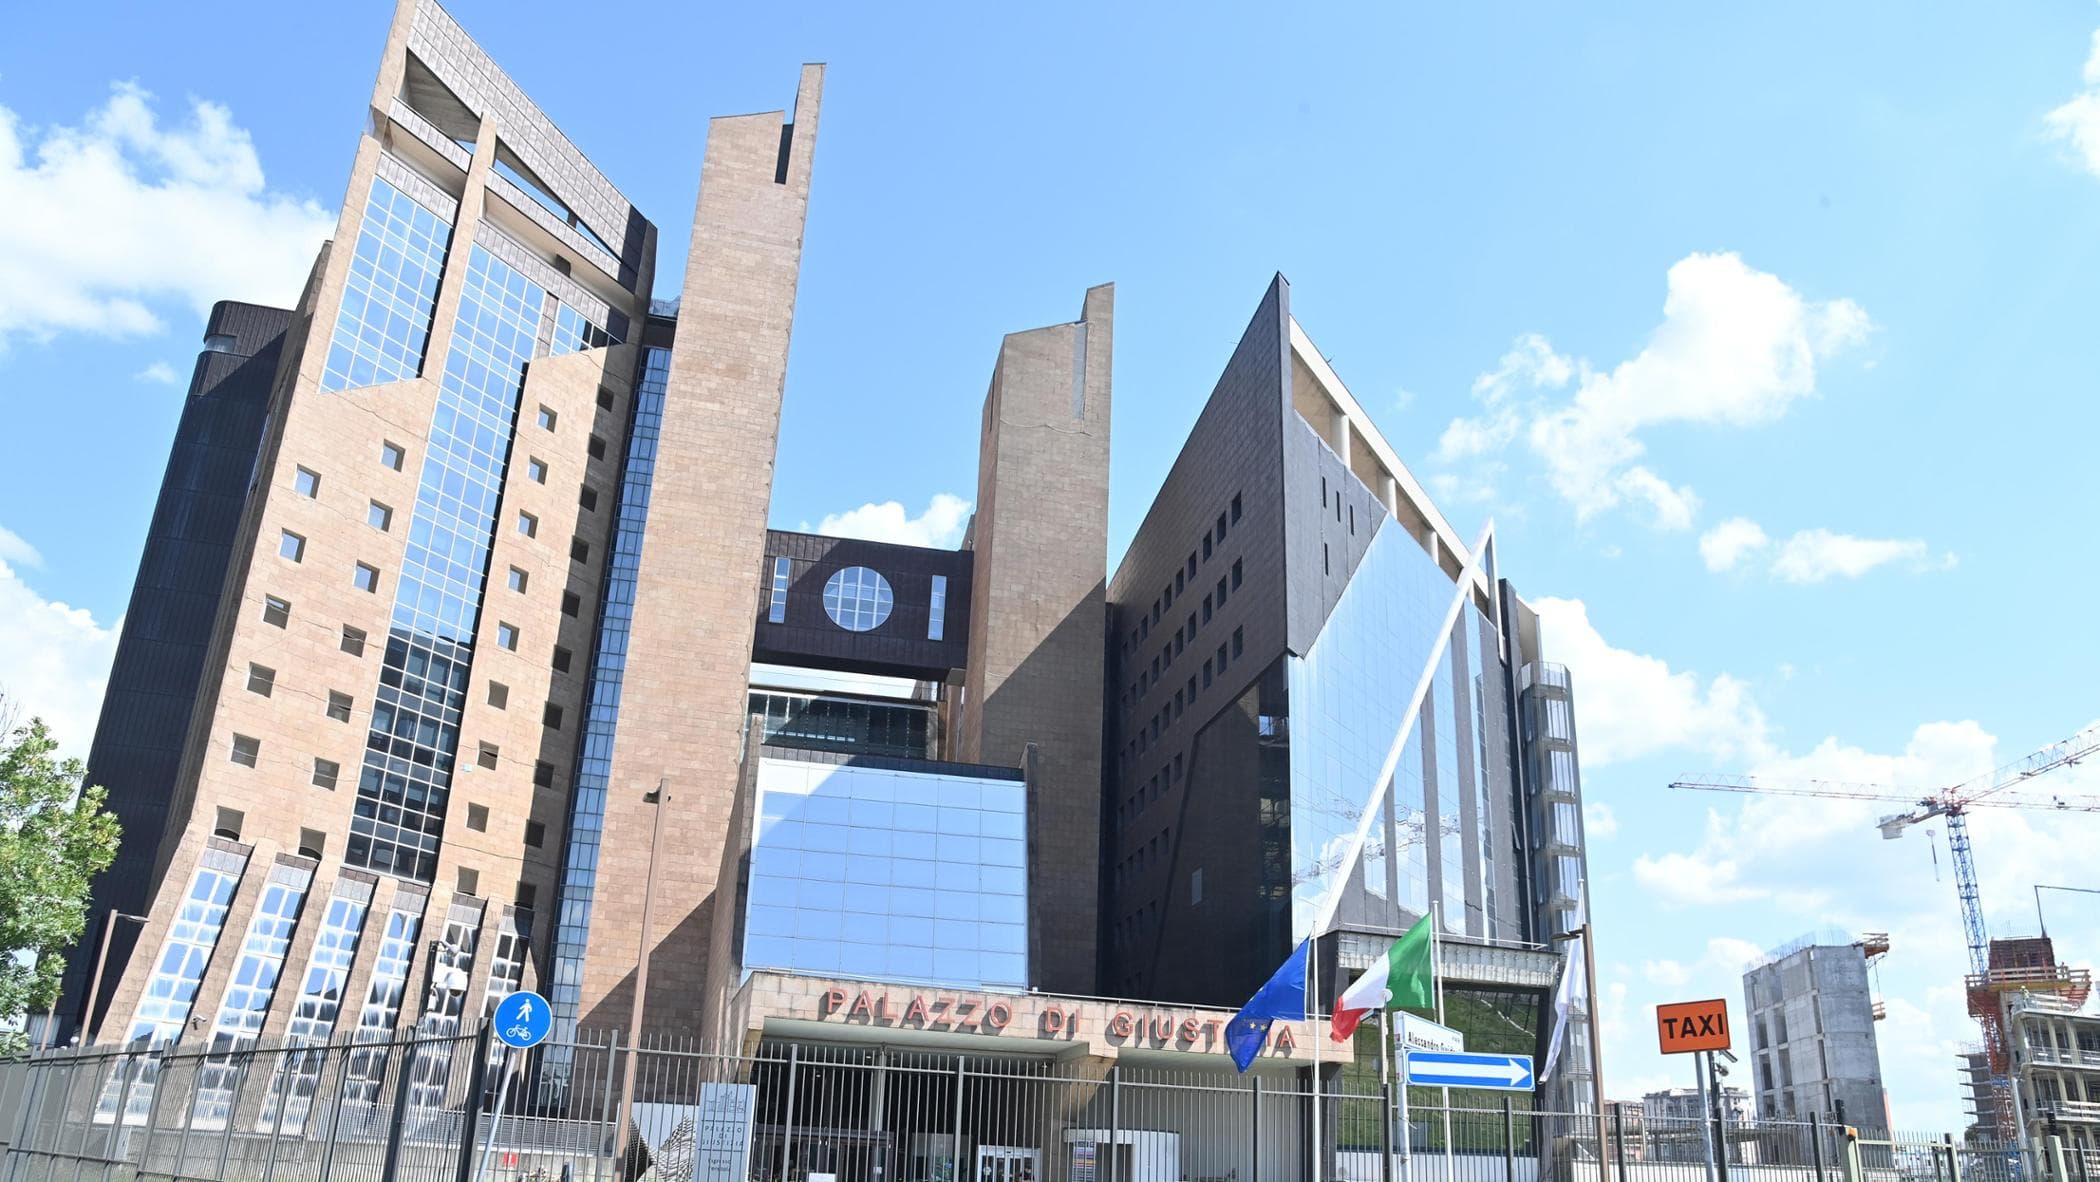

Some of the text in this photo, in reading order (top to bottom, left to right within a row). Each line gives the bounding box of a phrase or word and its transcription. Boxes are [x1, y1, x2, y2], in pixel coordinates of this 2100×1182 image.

[826, 987, 1297, 1049] PALAZZO DI GIUSTIA
[1662, 1013, 1725, 1040] TAXI
[1408, 1031, 1439, 1051] Alessandro
